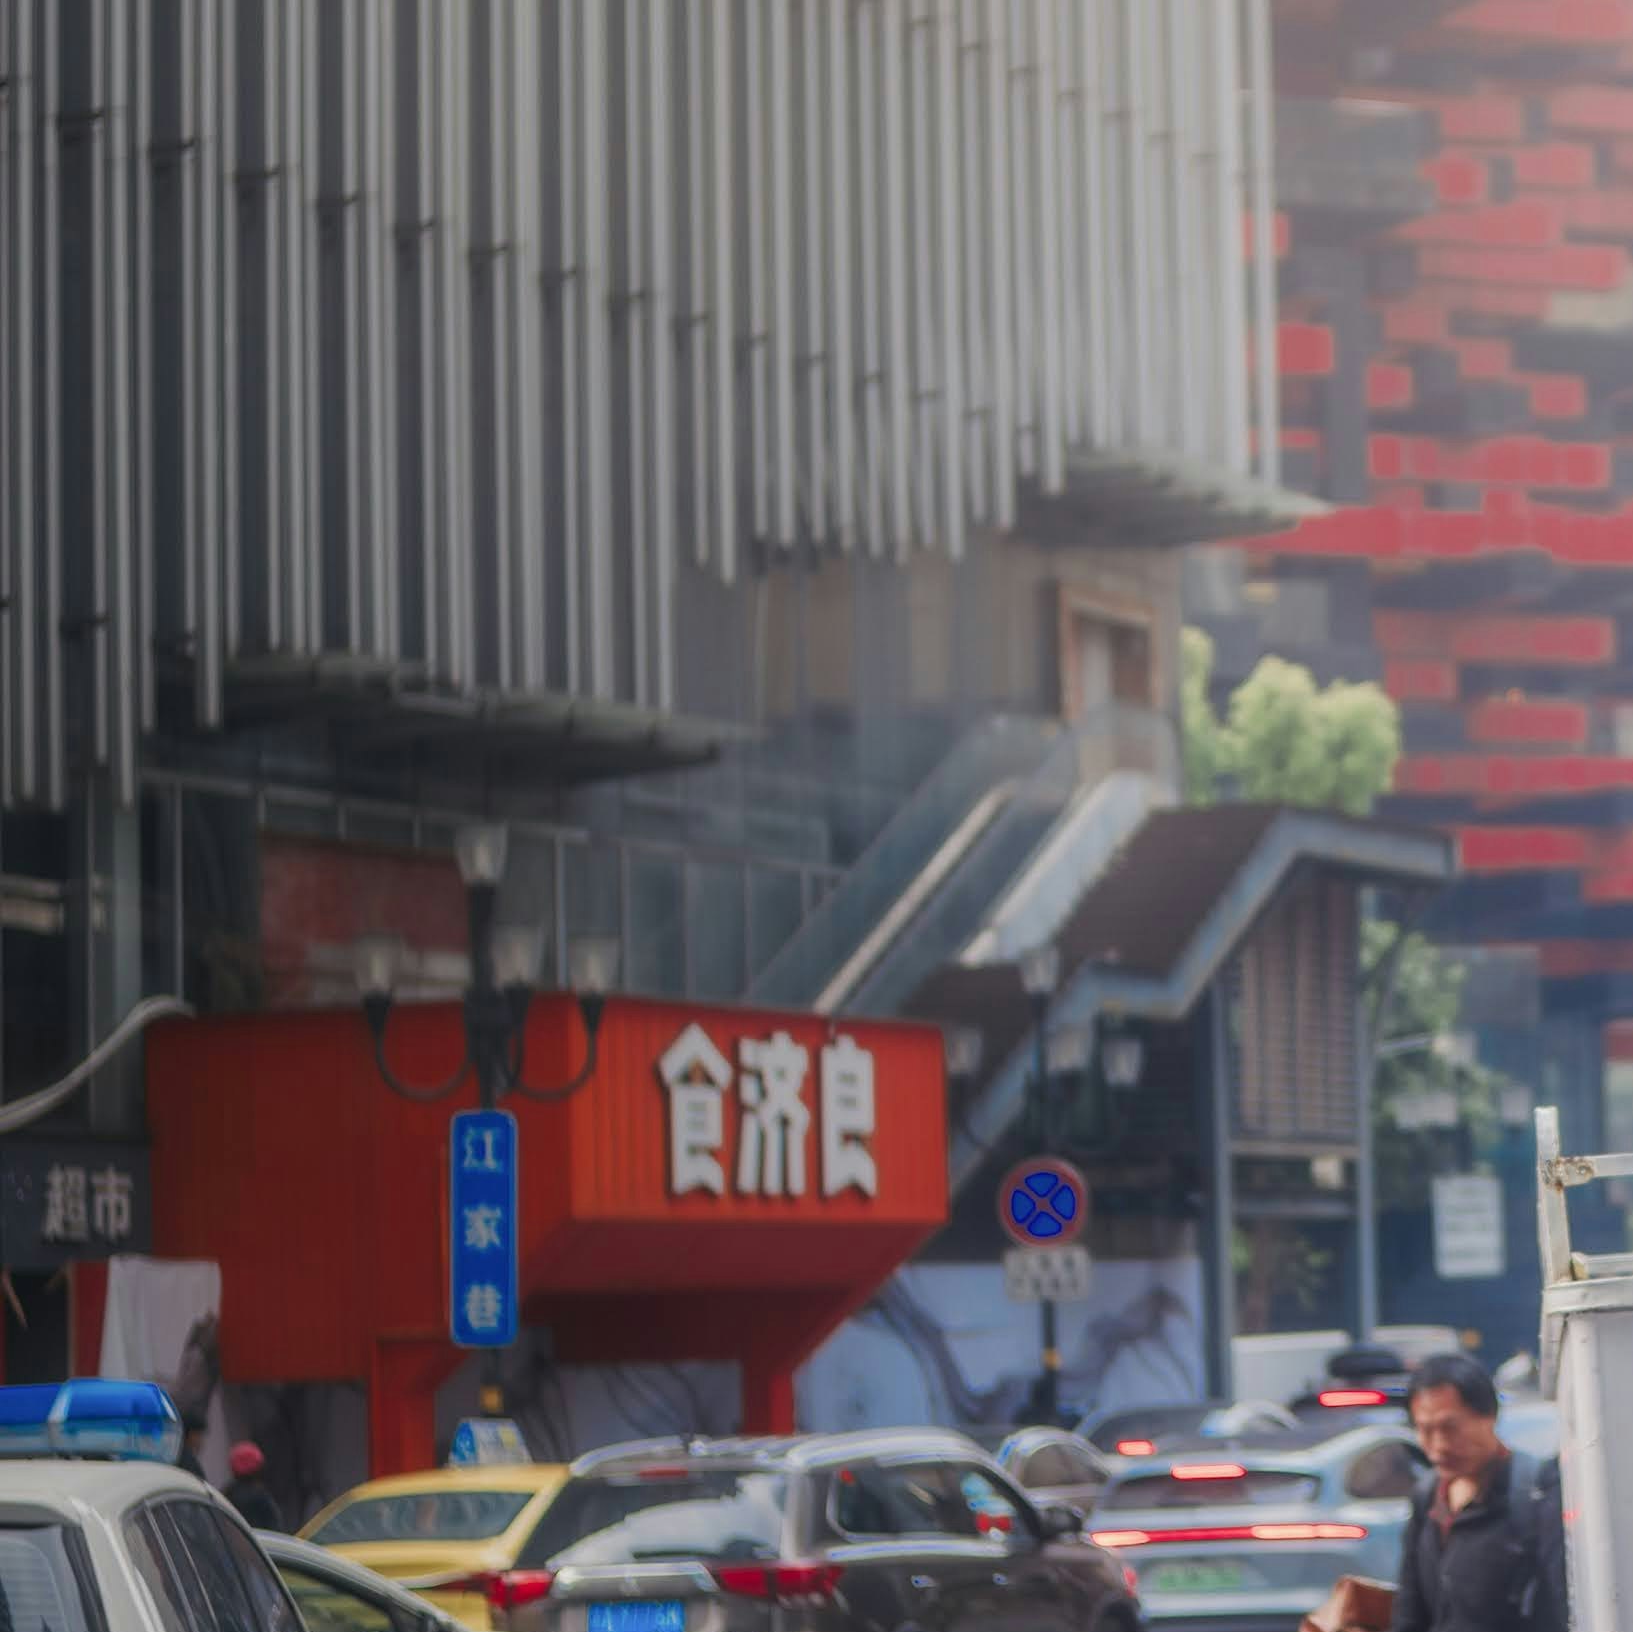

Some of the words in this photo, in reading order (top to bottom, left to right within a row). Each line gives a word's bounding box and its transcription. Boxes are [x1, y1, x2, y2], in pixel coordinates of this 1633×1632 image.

[659, 1022, 877, 1199] 食济良
[463, 1128, 502, 1329] 江家巷
